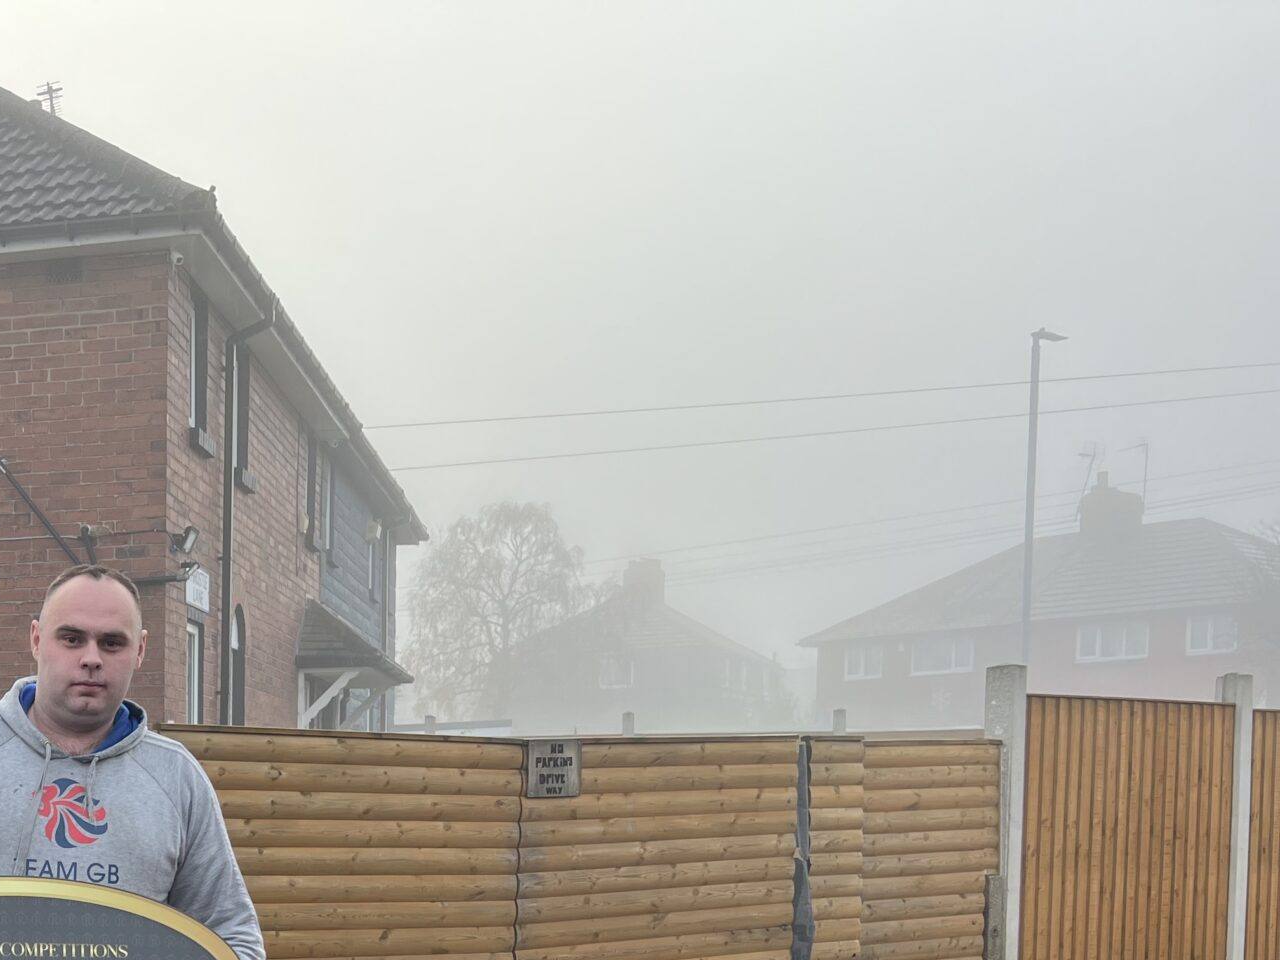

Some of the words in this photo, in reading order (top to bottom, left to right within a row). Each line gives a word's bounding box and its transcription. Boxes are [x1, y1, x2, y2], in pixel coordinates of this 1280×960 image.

[551, 744, 563, 754] NO
[536, 757, 572, 768] PARKING
[539, 774, 565, 784] DRIVE
[546, 787, 562, 795] WAY
[14, 858, 78, 881] EAM
[87, 863, 120, 885] GB
[0, 942, 129, 959] COMPETITIONS
